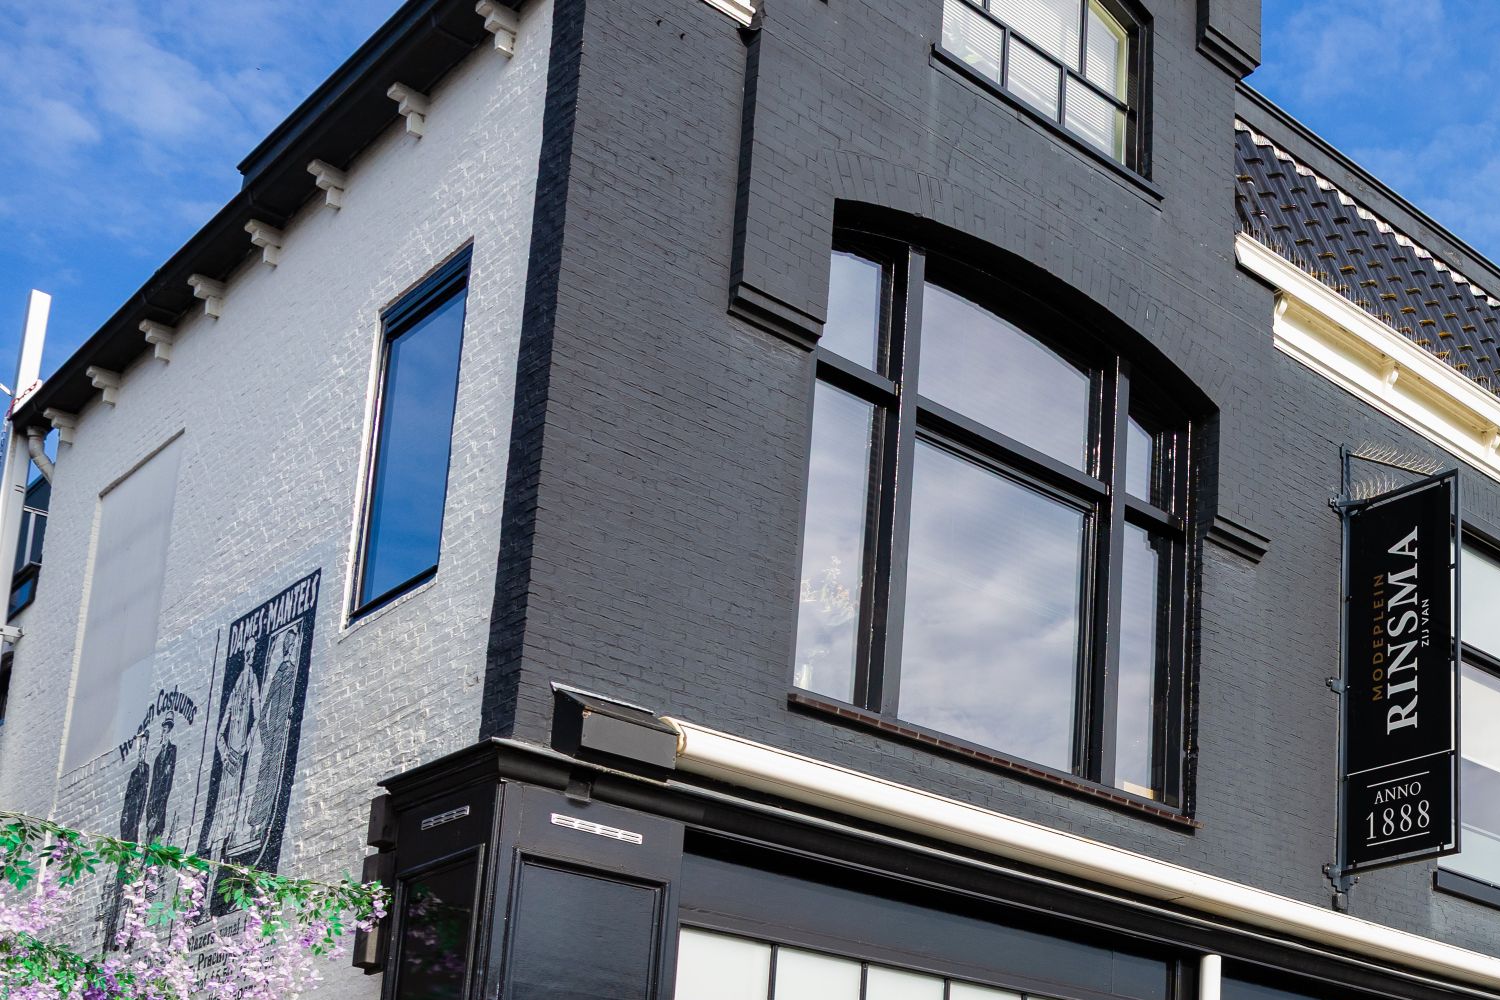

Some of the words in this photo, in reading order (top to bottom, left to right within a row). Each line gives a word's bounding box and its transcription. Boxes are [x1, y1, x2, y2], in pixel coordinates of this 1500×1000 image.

[1386, 526, 1418, 735] RINSMA
[1421, 598, 1430, 623] VAN
[1372, 574, 1384, 701] MODEPLEIN
[1421, 624, 1430, 648] ZIJ
[156, 685, 198, 725] Costuums
[1374, 781, 1421, 805] ANNO
[1365, 799, 1430, 840] 1888
